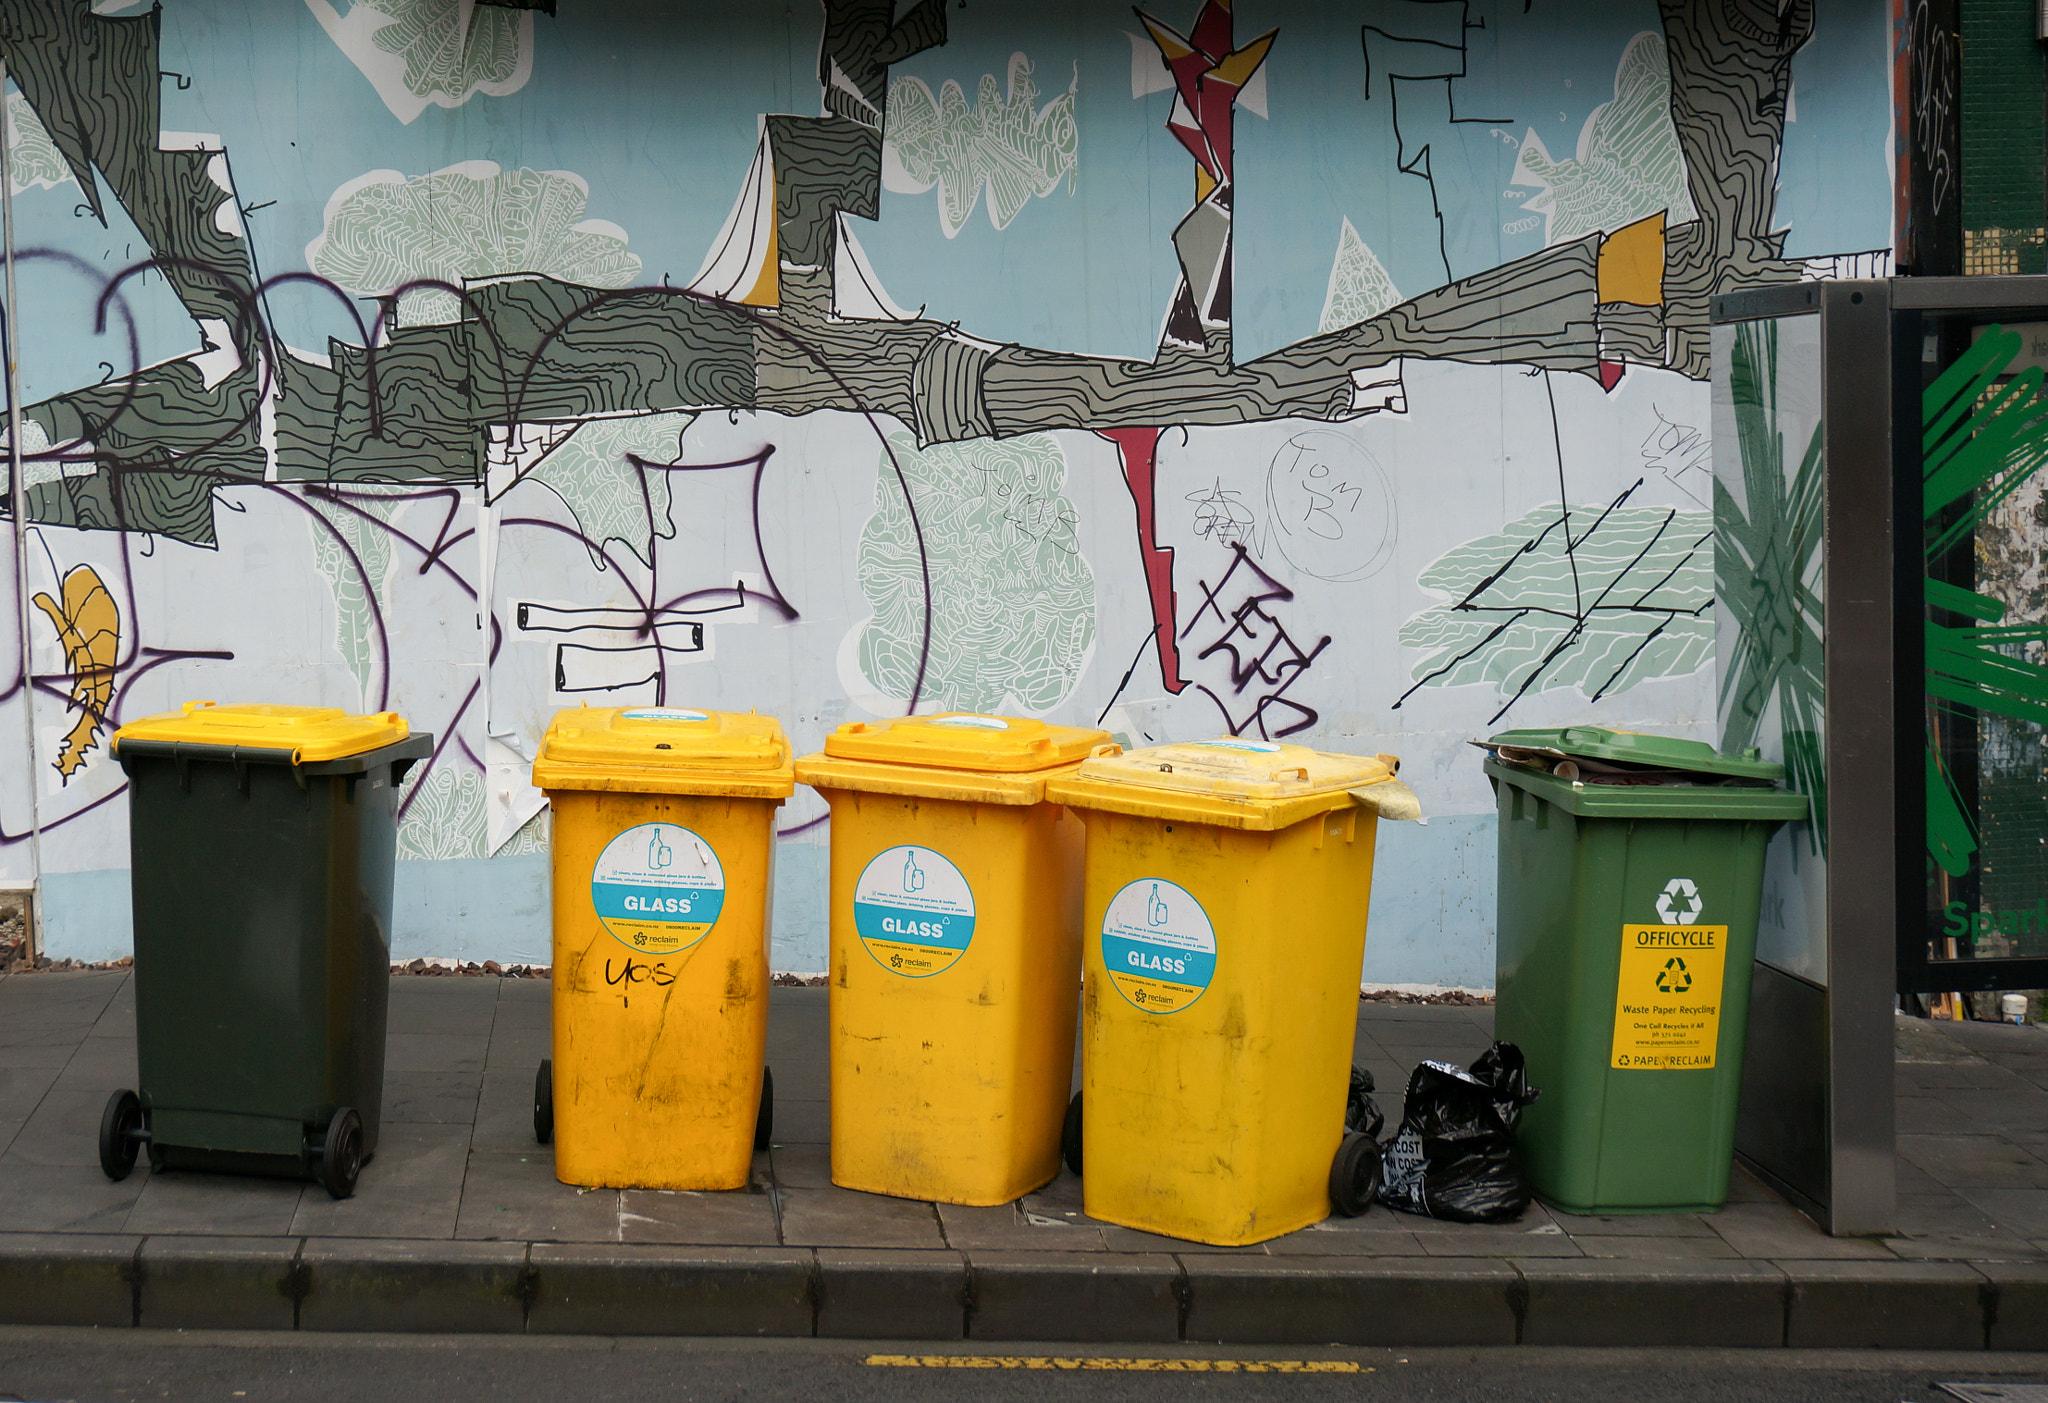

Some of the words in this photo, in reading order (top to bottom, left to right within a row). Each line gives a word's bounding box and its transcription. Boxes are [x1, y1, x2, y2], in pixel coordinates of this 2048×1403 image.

[624, 896, 692, 914] GLASS
[882, 918, 943, 938] GLASS
[649, 936, 678, 944] reclaim
[1637, 931, 1715, 946] OFFICYCLE
[905, 959, 931, 968] reclaim
[1127, 951, 1186, 974] GLASS
[1148, 994, 1173, 1004] reclaim
[1623, 1005, 1650, 1014] Waste
[1653, 1006, 1676, 1016] Paper
[1679, 1005, 1715, 1016] Recycling
[1670, 1055, 1711, 1065] RECLAIM
[1394, 1141, 1420, 1154] COST
